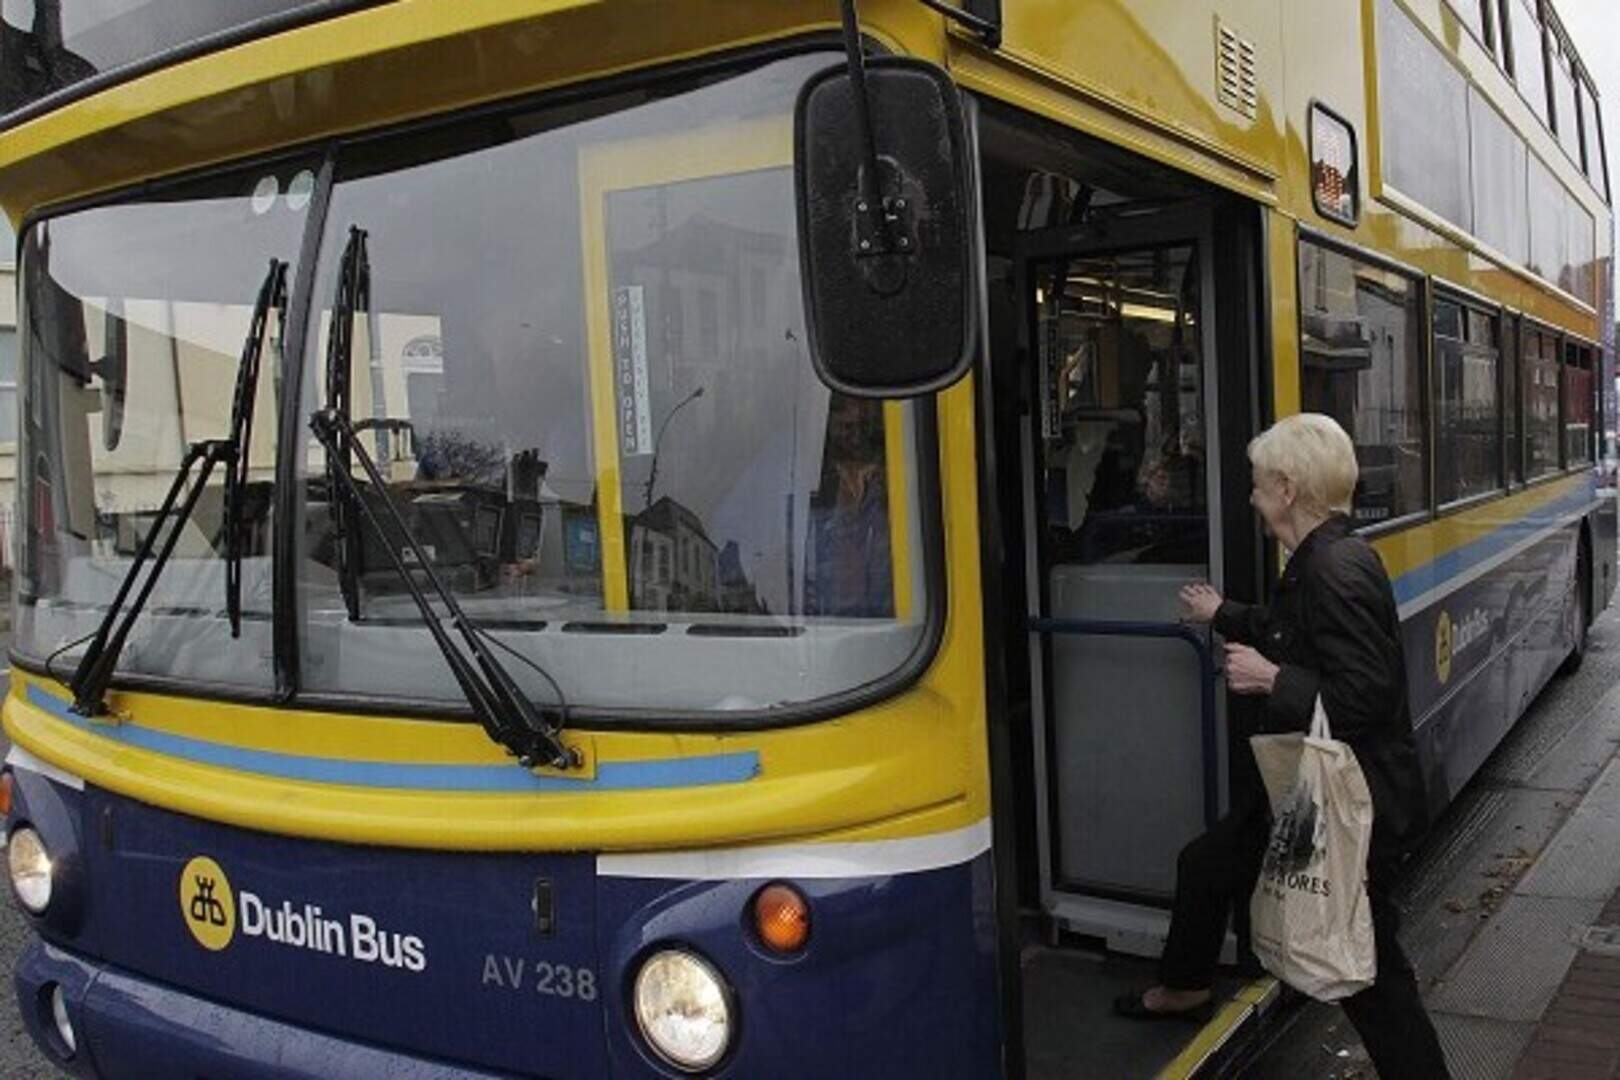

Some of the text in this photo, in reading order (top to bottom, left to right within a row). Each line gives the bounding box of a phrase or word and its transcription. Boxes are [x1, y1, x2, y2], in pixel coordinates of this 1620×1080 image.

[239, 890, 425, 971] Dublin Bus
[482, 955, 597, 1001] AV 238
